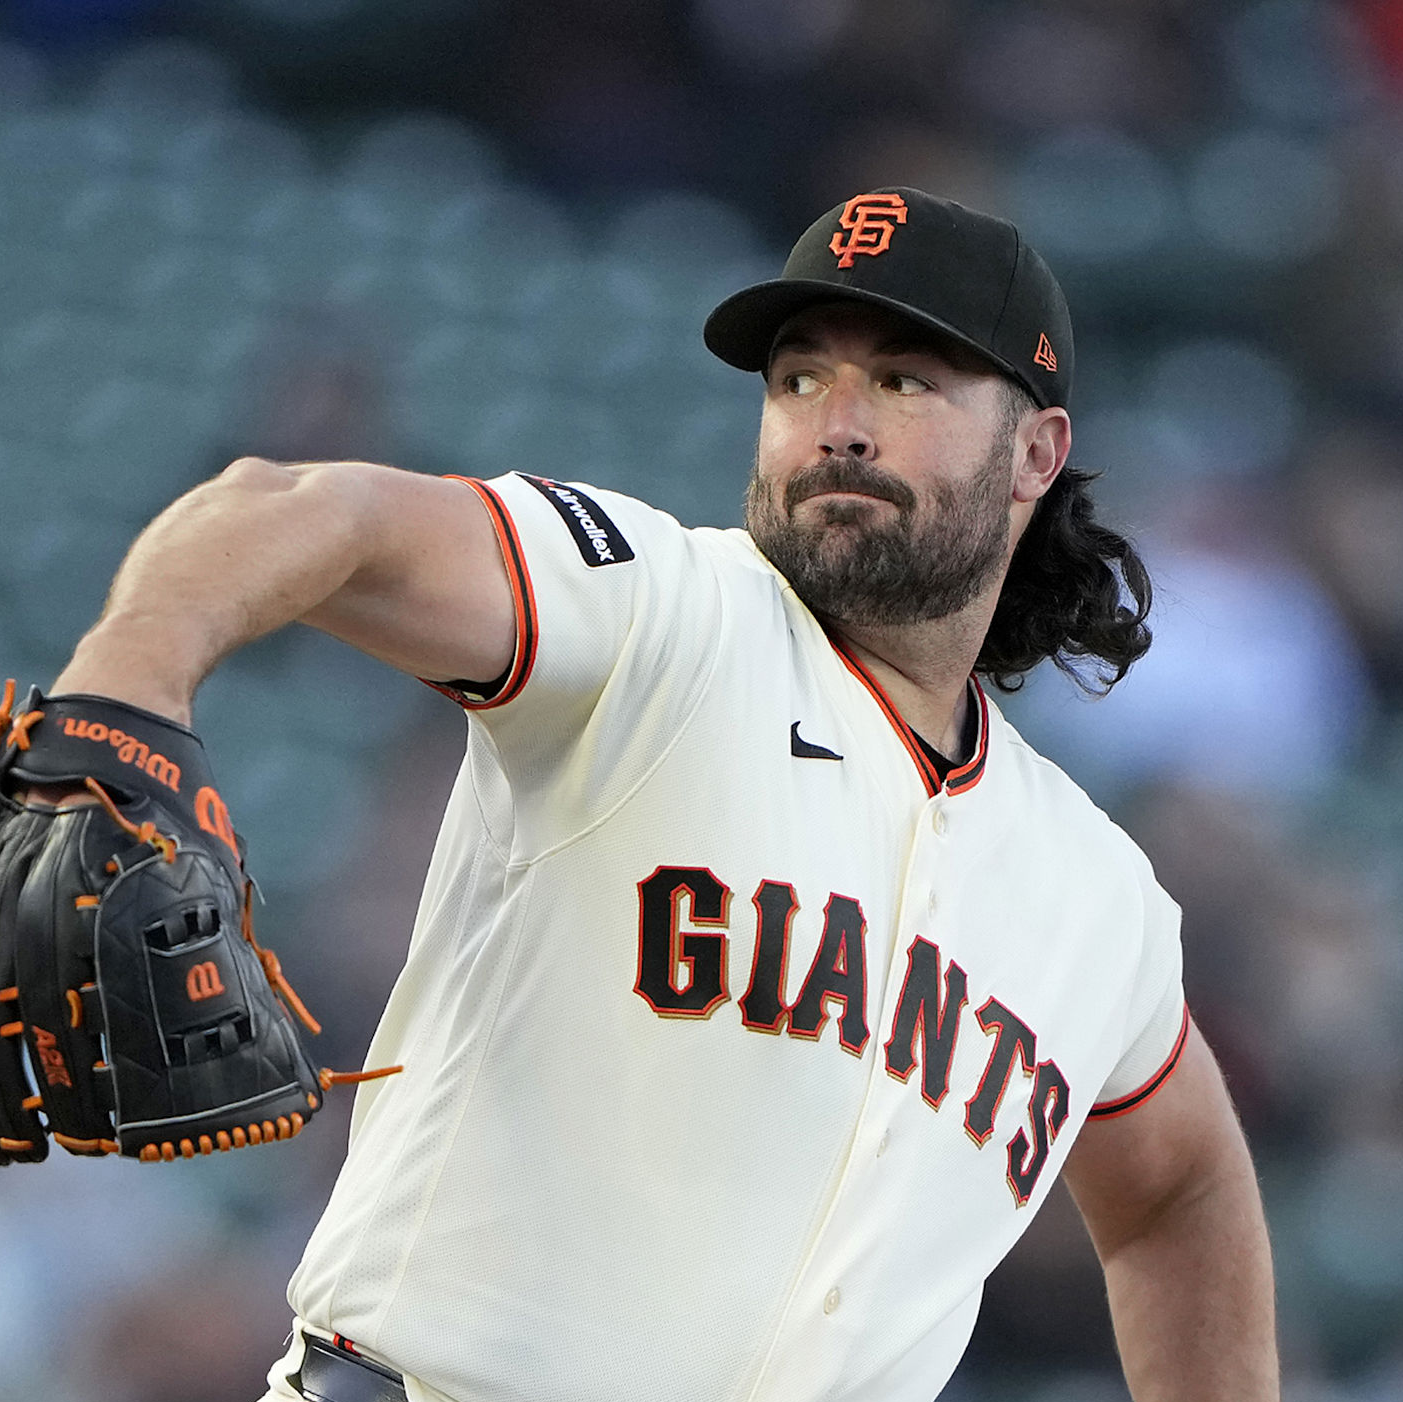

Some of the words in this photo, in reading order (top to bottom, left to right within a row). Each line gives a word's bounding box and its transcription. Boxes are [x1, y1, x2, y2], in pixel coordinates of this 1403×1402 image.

[829, 194, 907, 268] SF
[549, 487, 615, 562] Airwallex
[64, 717, 181, 792] Wilson
[633, 865, 1070, 1209] GIANTS
